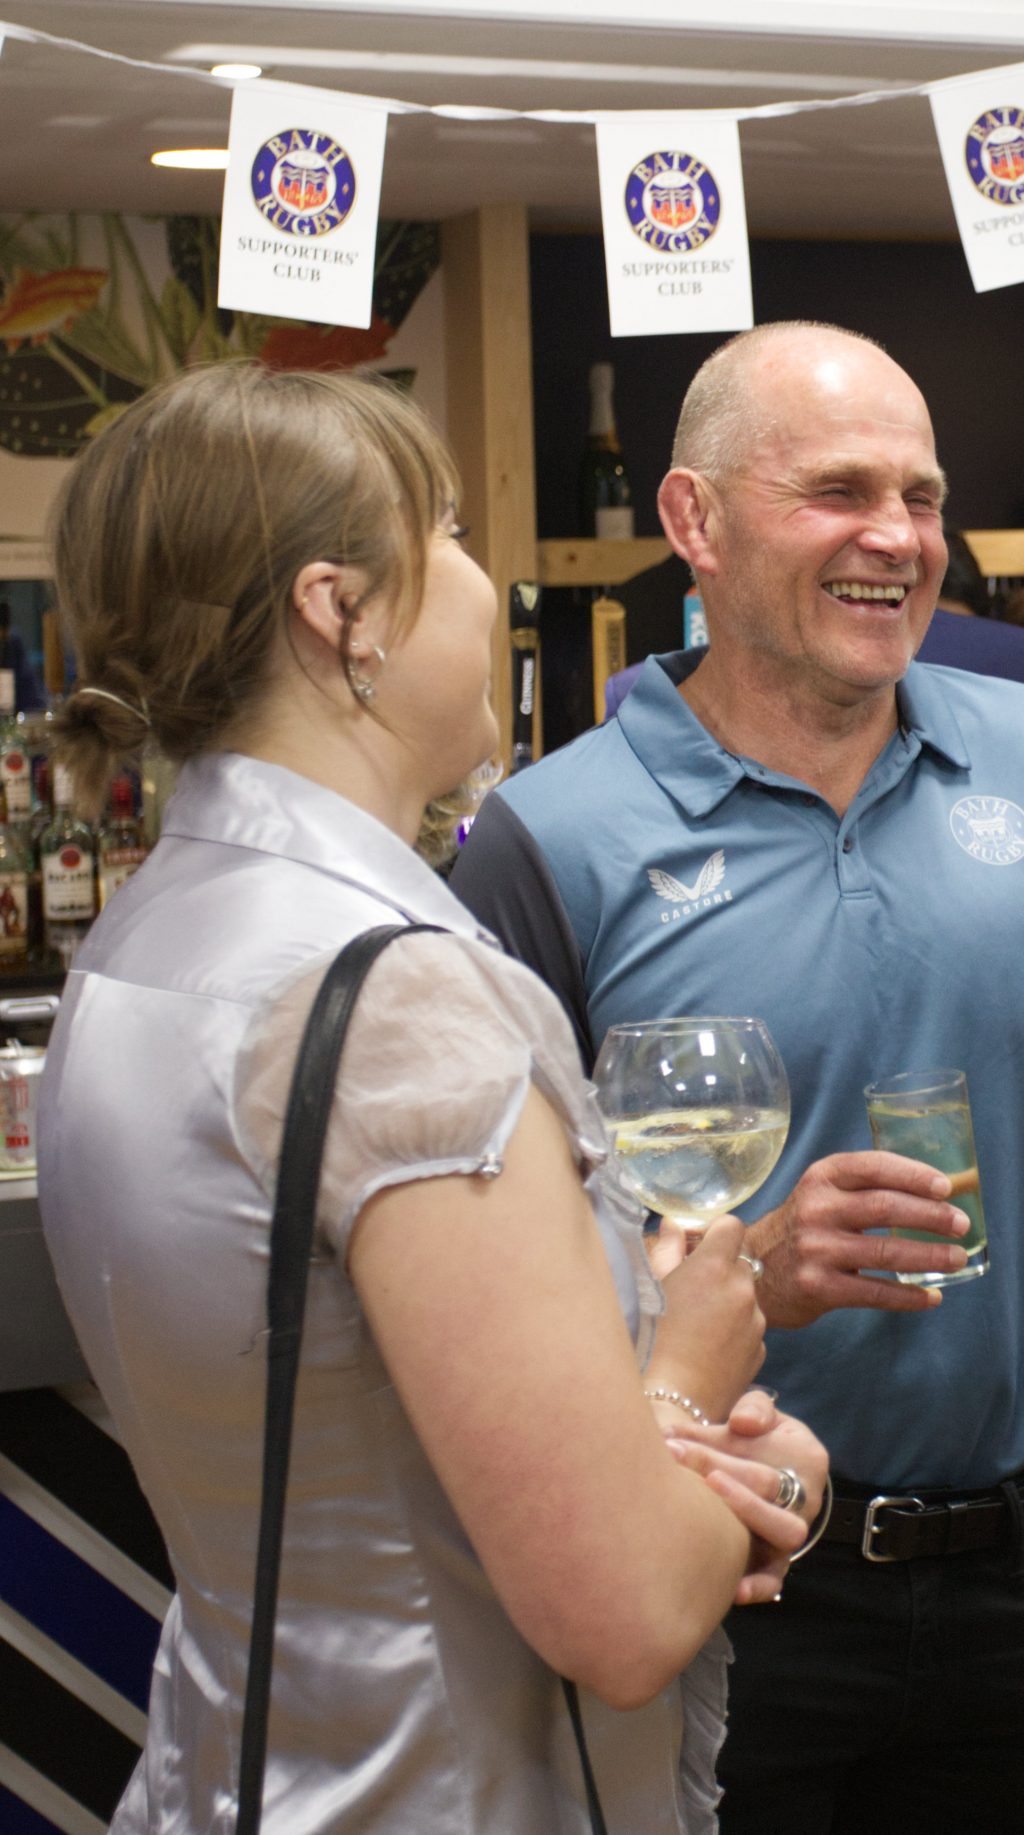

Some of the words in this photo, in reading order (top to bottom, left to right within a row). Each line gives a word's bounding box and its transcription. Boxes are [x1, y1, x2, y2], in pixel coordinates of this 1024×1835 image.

[265, 130, 345, 166] BATH
[633, 151, 705, 183] BATH
[257, 196, 347, 236] RUGBY
[634, 213, 715, 252] RUGBY
[237, 236, 359, 267] SUPPORTERS'
[273, 263, 321, 282] CLUB
[622, 259, 735, 277] SUPPORTERS'
[657, 282, 703, 297] CLUB
[955, 799, 1010, 820] BATH
[660, 889, 733, 923] CASTORE
